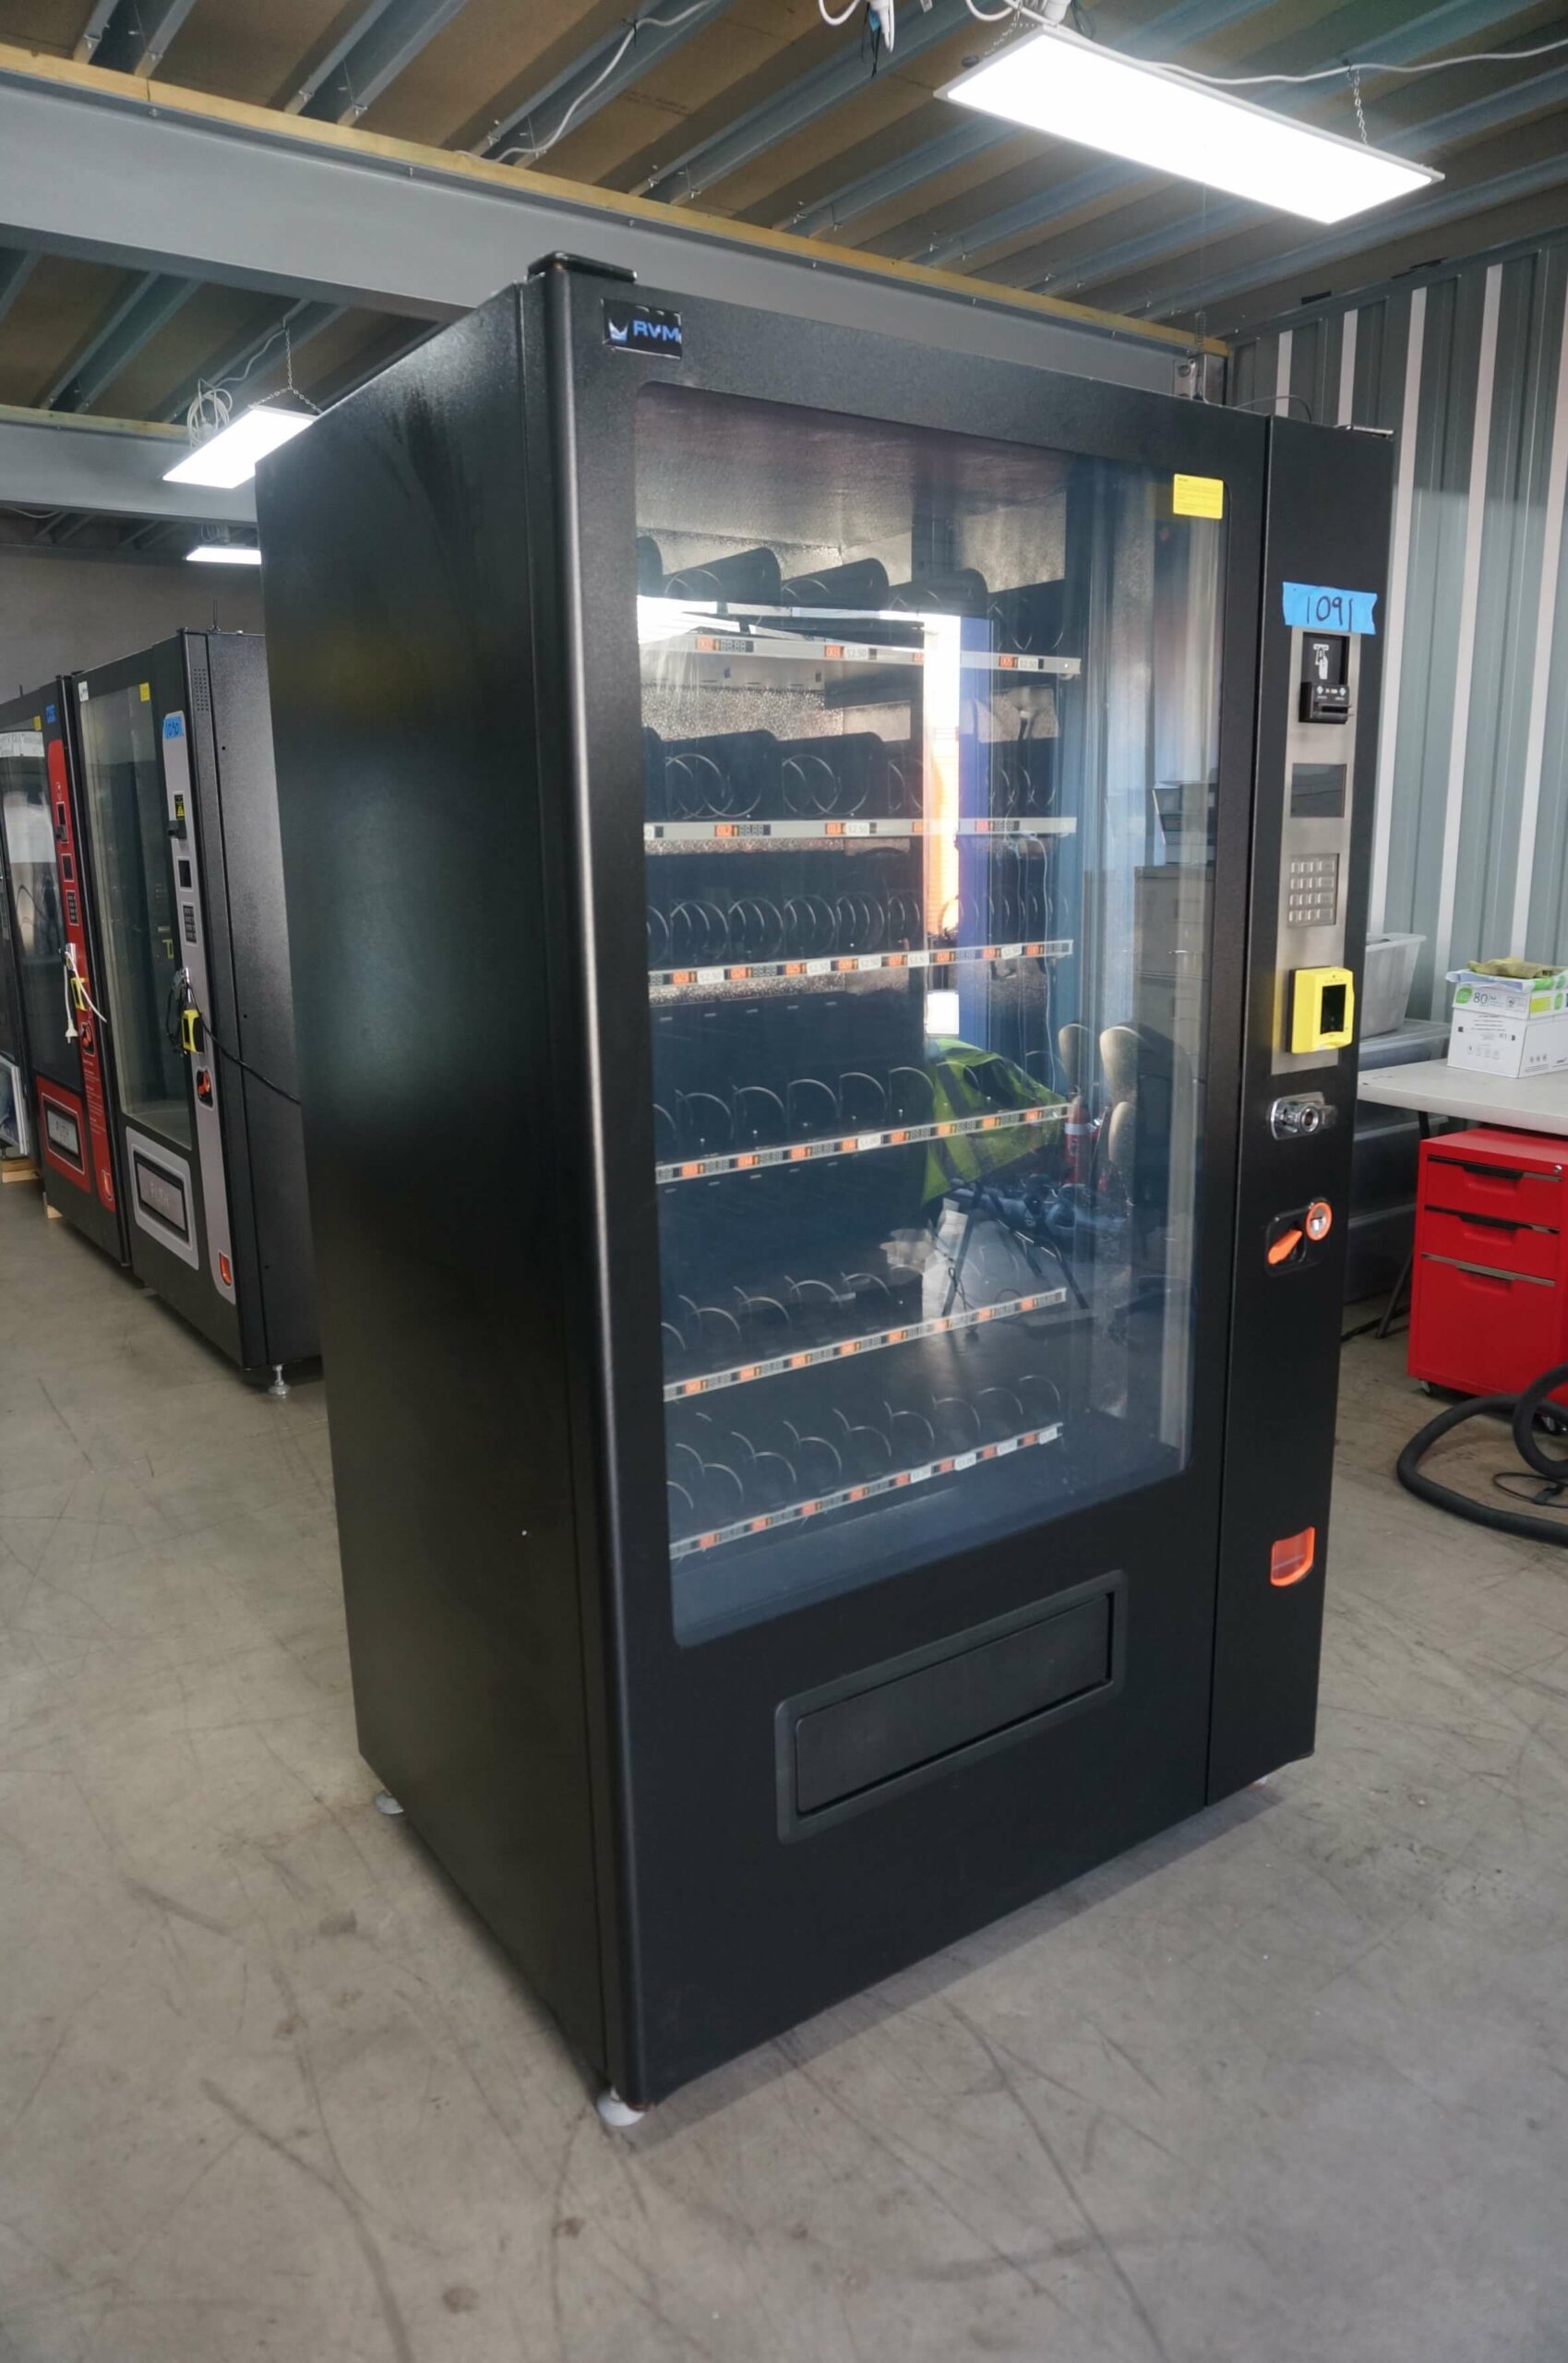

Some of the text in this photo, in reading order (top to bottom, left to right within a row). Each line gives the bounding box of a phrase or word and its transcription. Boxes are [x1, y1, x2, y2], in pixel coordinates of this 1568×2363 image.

[632, 318, 681, 343] RVM
[1306, 594, 1354, 632] 1091
[1473, 991, 1489, 1005] 80
